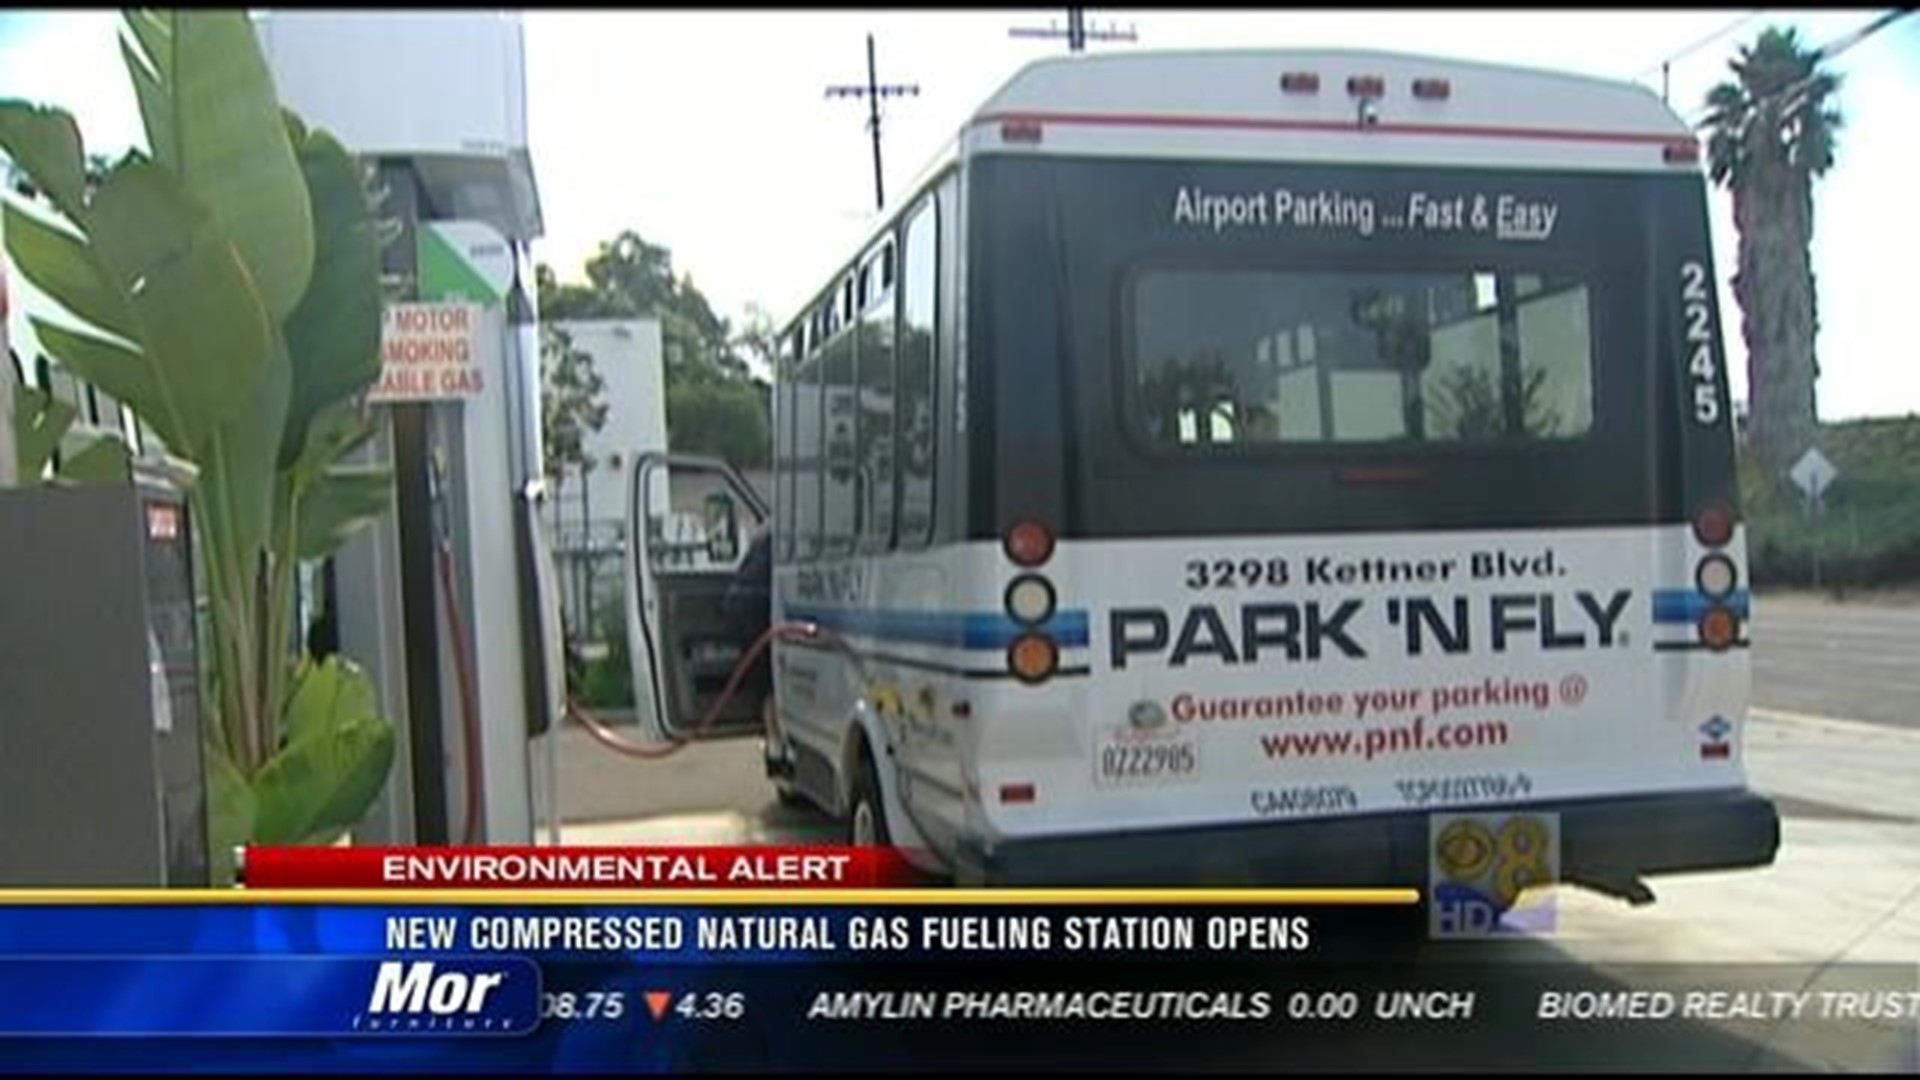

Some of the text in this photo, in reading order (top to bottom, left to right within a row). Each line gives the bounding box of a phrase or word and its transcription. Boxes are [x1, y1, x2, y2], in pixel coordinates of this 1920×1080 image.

[1174, 187, 1268, 234] Airport
[1274, 188, 1375, 236] Parking
[1408, 193, 1464, 230] Fast
[1470, 193, 1489, 231] &
[1497, 194, 1558, 241] Easy
[384, 339, 470, 362] MOKING
[1681, 263, 1719, 423] 2245
[440, 368, 484, 393] GAS
[1186, 549, 1567, 589] 3298 Kettner Blvd.
[1110, 590, 1632, 671] PARK 'N FLY
[1171, 673, 1588, 723] Guarantee your parking @
[1260, 716, 1508, 760] www.pnf.com
